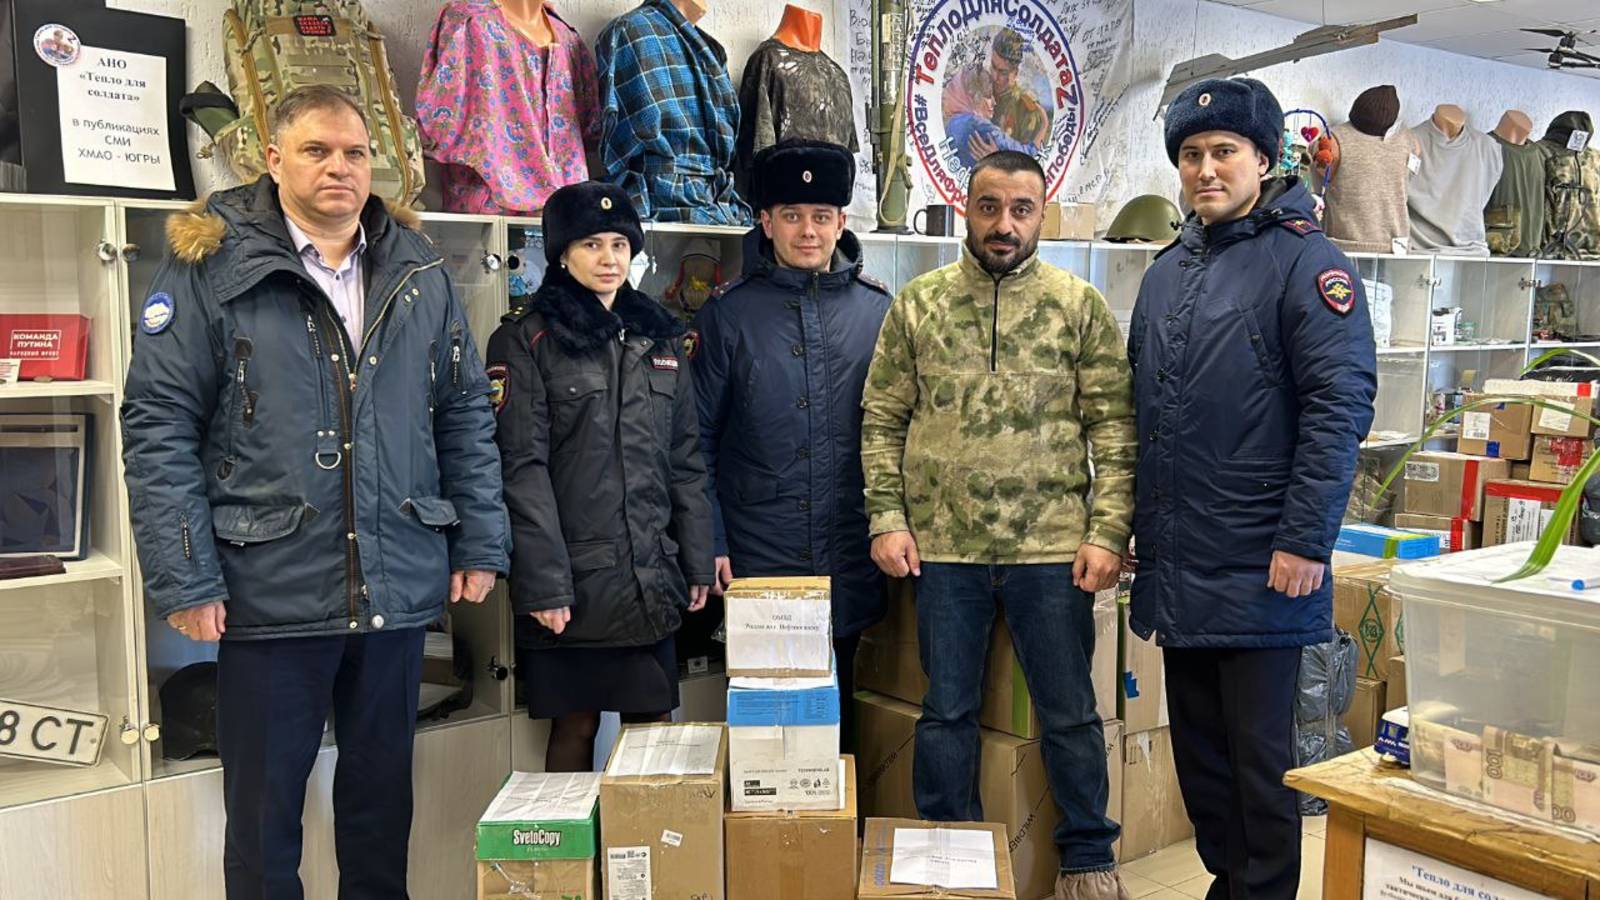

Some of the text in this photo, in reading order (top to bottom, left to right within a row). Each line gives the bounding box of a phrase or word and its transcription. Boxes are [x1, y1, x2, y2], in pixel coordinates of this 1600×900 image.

[97, 57, 127, 69] АНО
[80, 71, 146, 88] «Тепло для
[88, 88, 140, 101] солдата»
[72, 118, 160, 136] в публикациях
[104, 134, 131, 147] СМИ
[78, 147, 113, 161] ХМАО
[124, 152, 161, 165] ЮГРЫ
[13, 333, 59, 341] КОМАНДА
[513, 828, 561, 847] SvetoCopy
[1452, 882, 1476, 897] для
